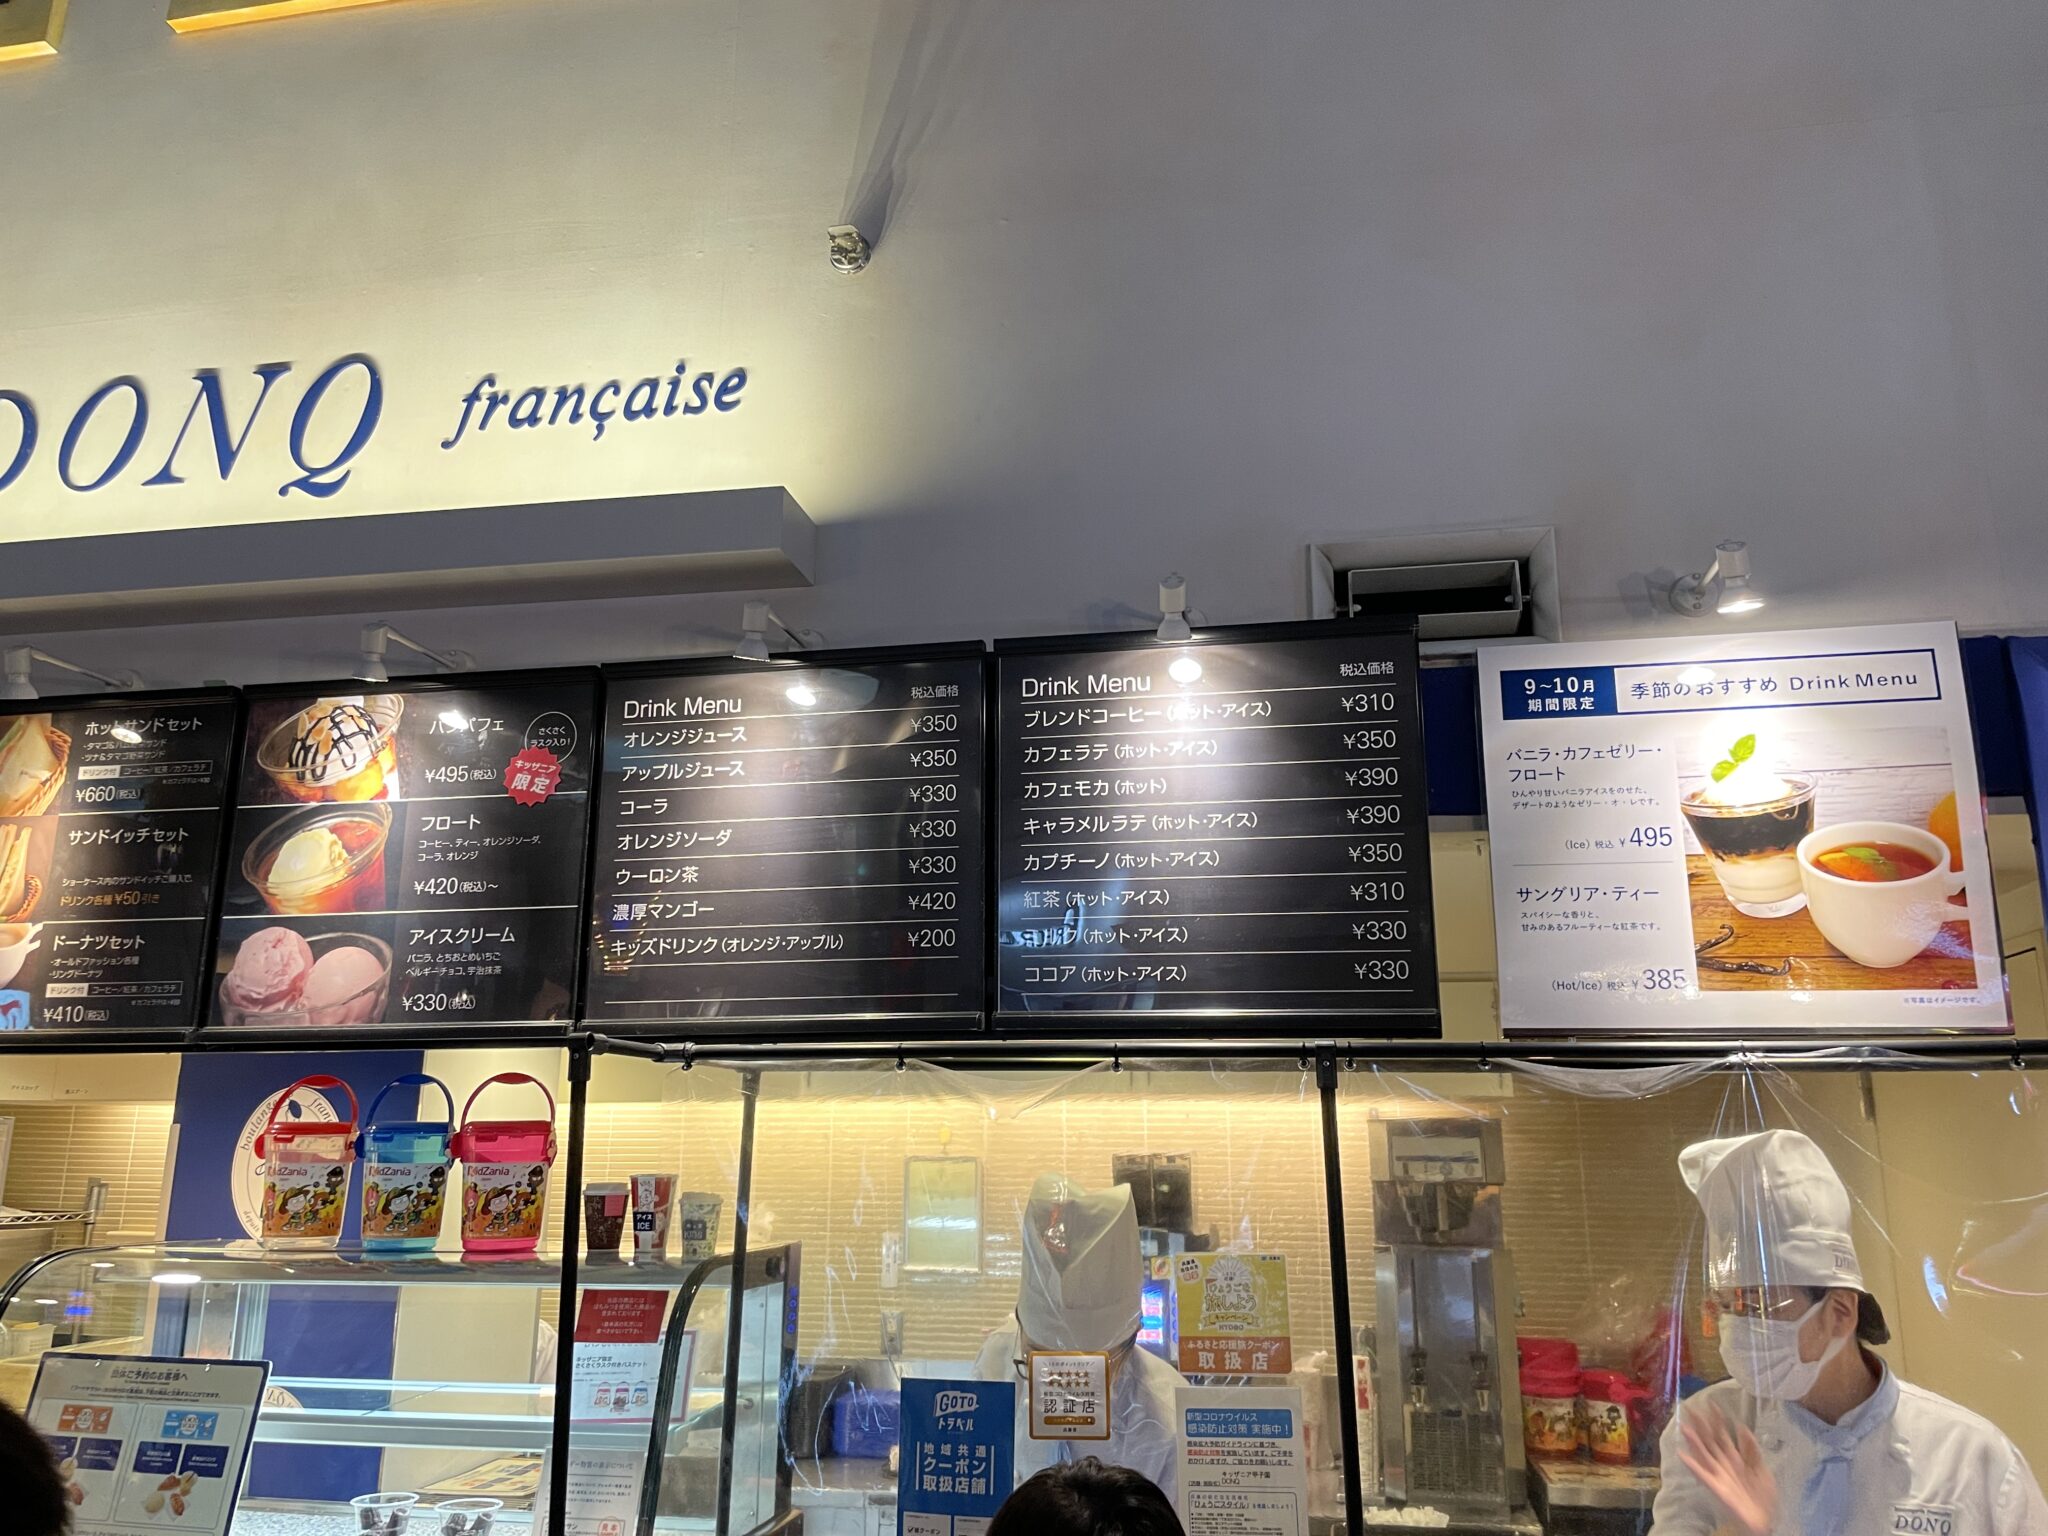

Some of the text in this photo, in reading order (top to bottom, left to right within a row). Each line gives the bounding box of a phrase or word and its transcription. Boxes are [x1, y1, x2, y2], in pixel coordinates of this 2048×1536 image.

[440, 359, 749, 450] française
[1021, 661, 1395, 698] Drink Menu 税込価格
[1789, 674, 1850, 692] Drink
[1856, 671, 1919, 689] Menu
[624, 684, 959, 719] Drink Menu 税込価格
[1341, 692, 1395, 713] ¥310
[1527, 696, 1595, 712] 期間限定
[538, 726, 566, 736] さくさく
[624, 713, 957, 748] オレンジジュース ¥350
[1343, 729, 1396, 750] ¥350
[514, 759, 557, 773] キッザニア
[622, 748, 957, 782] アップルジュース ¥350
[1508, 766, 1566, 783] フロート
[511, 774, 551, 794] 限定
[1345, 766, 1398, 787] ¥390
[620, 784, 957, 815] コーラ ¥330
[421, 814, 481, 831] フロート
[1346, 804, 1400, 825] ¥390
[617, 819, 957, 850] オレンジソーダ ¥330
[1348, 842, 1403, 863] ¥350
[615, 855, 957, 885] ウーロン茶 ¥330
[1350, 881, 1405, 902] ¥310
[1516, 886, 1660, 903] サングリア・ティー
[612, 891, 956, 921] 濃厚マンゴー ¥420
[409, 927, 515, 946] アイスクリーム
[907, 928, 956, 947] ¥200
[1352, 920, 1407, 941] ¥330
[53, 935, 146, 951] ドーナツセット
[1354, 960, 1409, 980] ¥330
[267, 1165, 308, 1177] KidZania
[369, 1165, 410, 1177] KidZania
[467, 1165, 508, 1177] KidZania
[637, 1222, 651, 1230] ICE
[1198, 1351, 1268, 1371] 取扱店
[1044, 1399, 1095, 1414] 認証店
[1187, 1412, 1258, 1421] 新型コロナウイルス
[938, 1417, 974, 1431] トラベル
[1188, 1424, 1248, 1435] 感染防止対策
[924, 1442, 987, 1457] 地域共通
[924, 1457, 987, 1475] クーポン
[923, 1475, 987, 1496] 取扱店舗
[1895, 1514, 1952, 1536] DONQ
